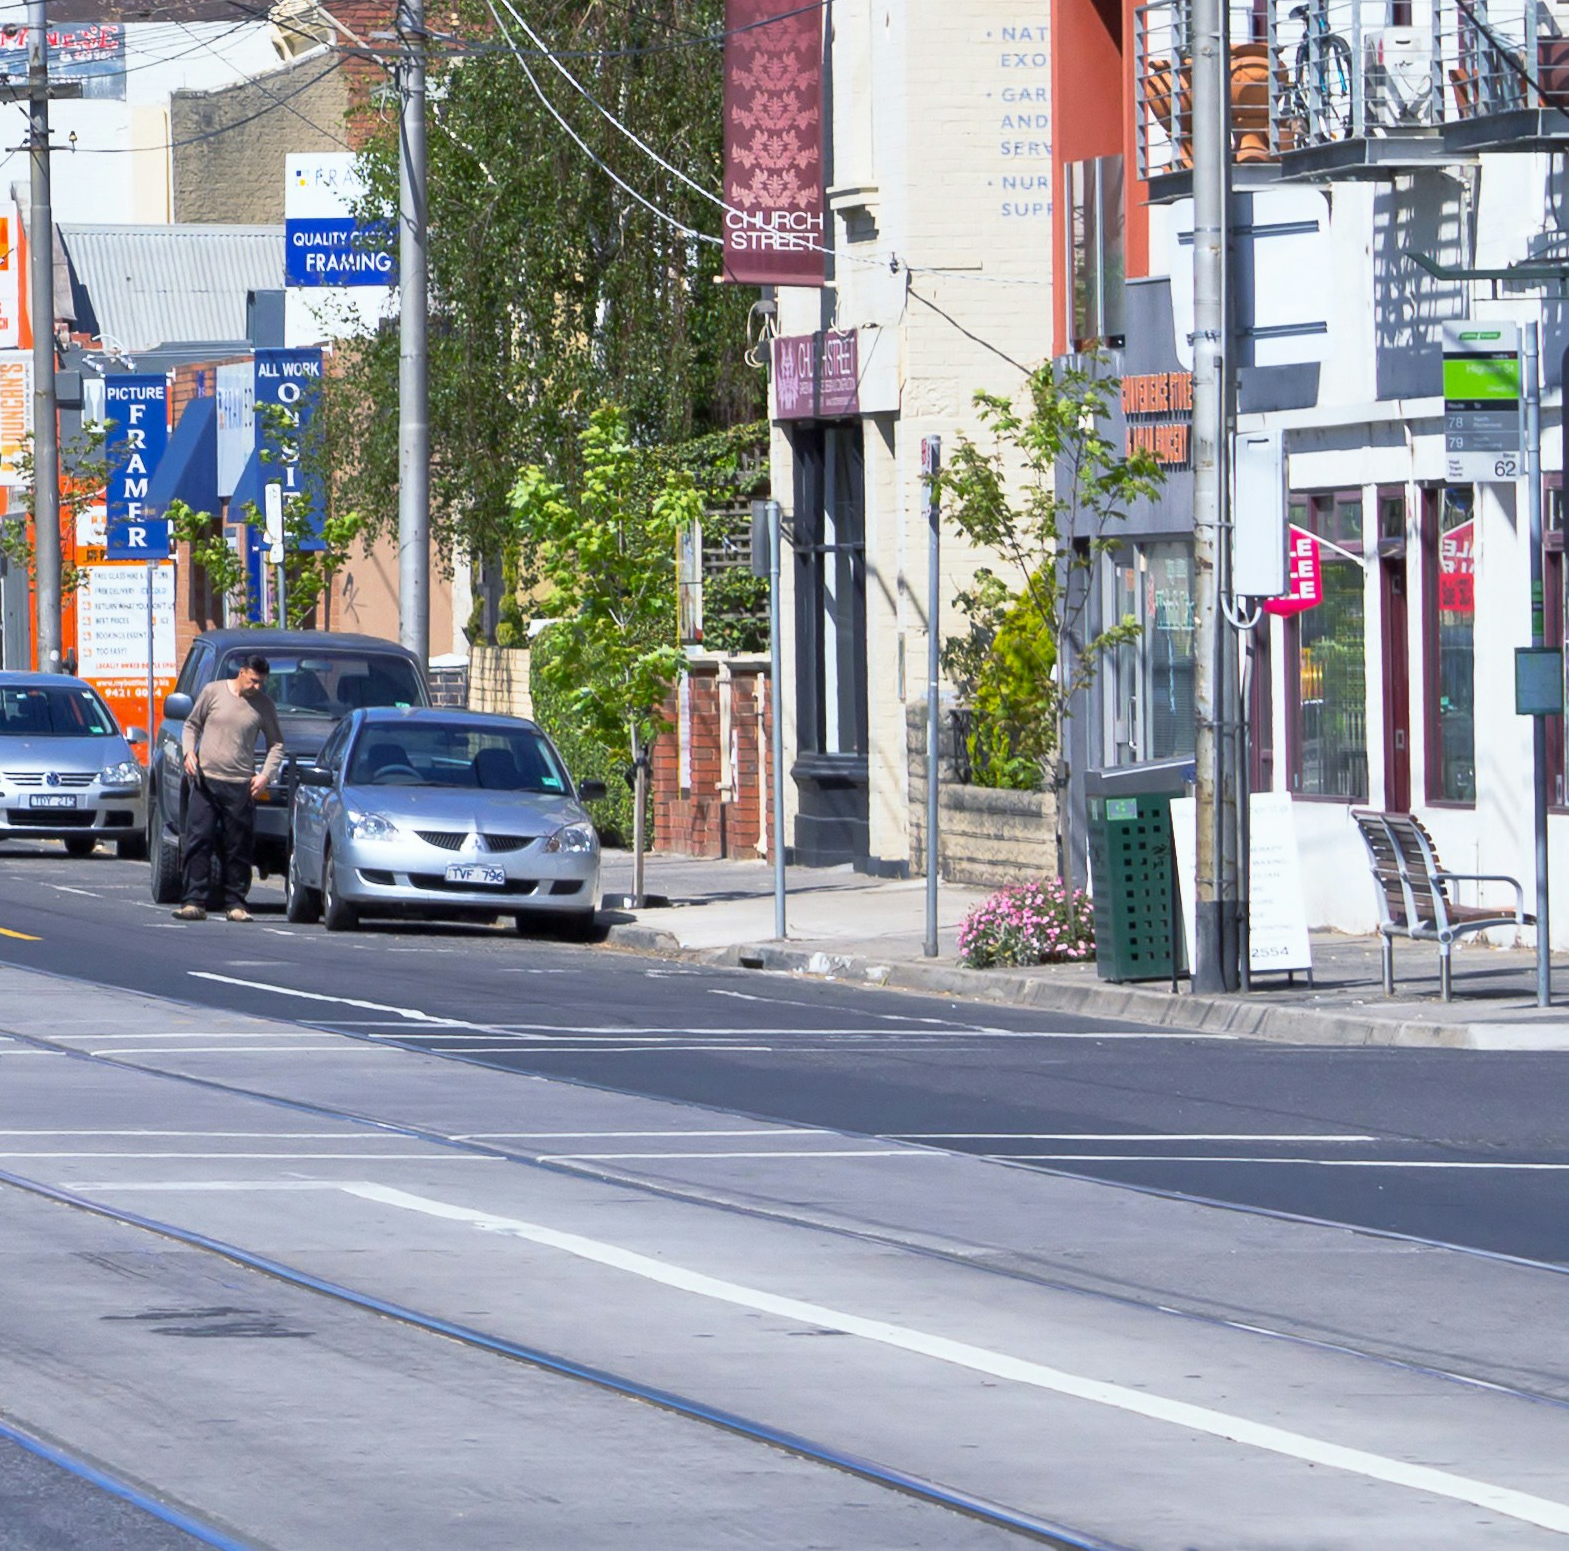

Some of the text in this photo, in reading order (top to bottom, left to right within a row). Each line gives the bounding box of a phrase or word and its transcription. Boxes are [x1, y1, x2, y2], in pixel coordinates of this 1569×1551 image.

[726, 210, 823, 230] CHURCH
[293, 232, 348, 246] QUALITY
[731, 232, 819, 250] STREET
[306, 252, 392, 272] FRAMING
[258, 362, 320, 377] ALL WORK
[107, 387, 164, 400] PICTURE
[1448, 417, 1464, 429] 78
[1448, 437, 1464, 449] 79
[124, 404, 149, 548] FRAMER
[1494, 461, 1517, 478] 62
[105, 688, 131, 699] 9421
[451, 868, 503, 882] TVF 796
[1251, 946, 1289, 957] 2554
